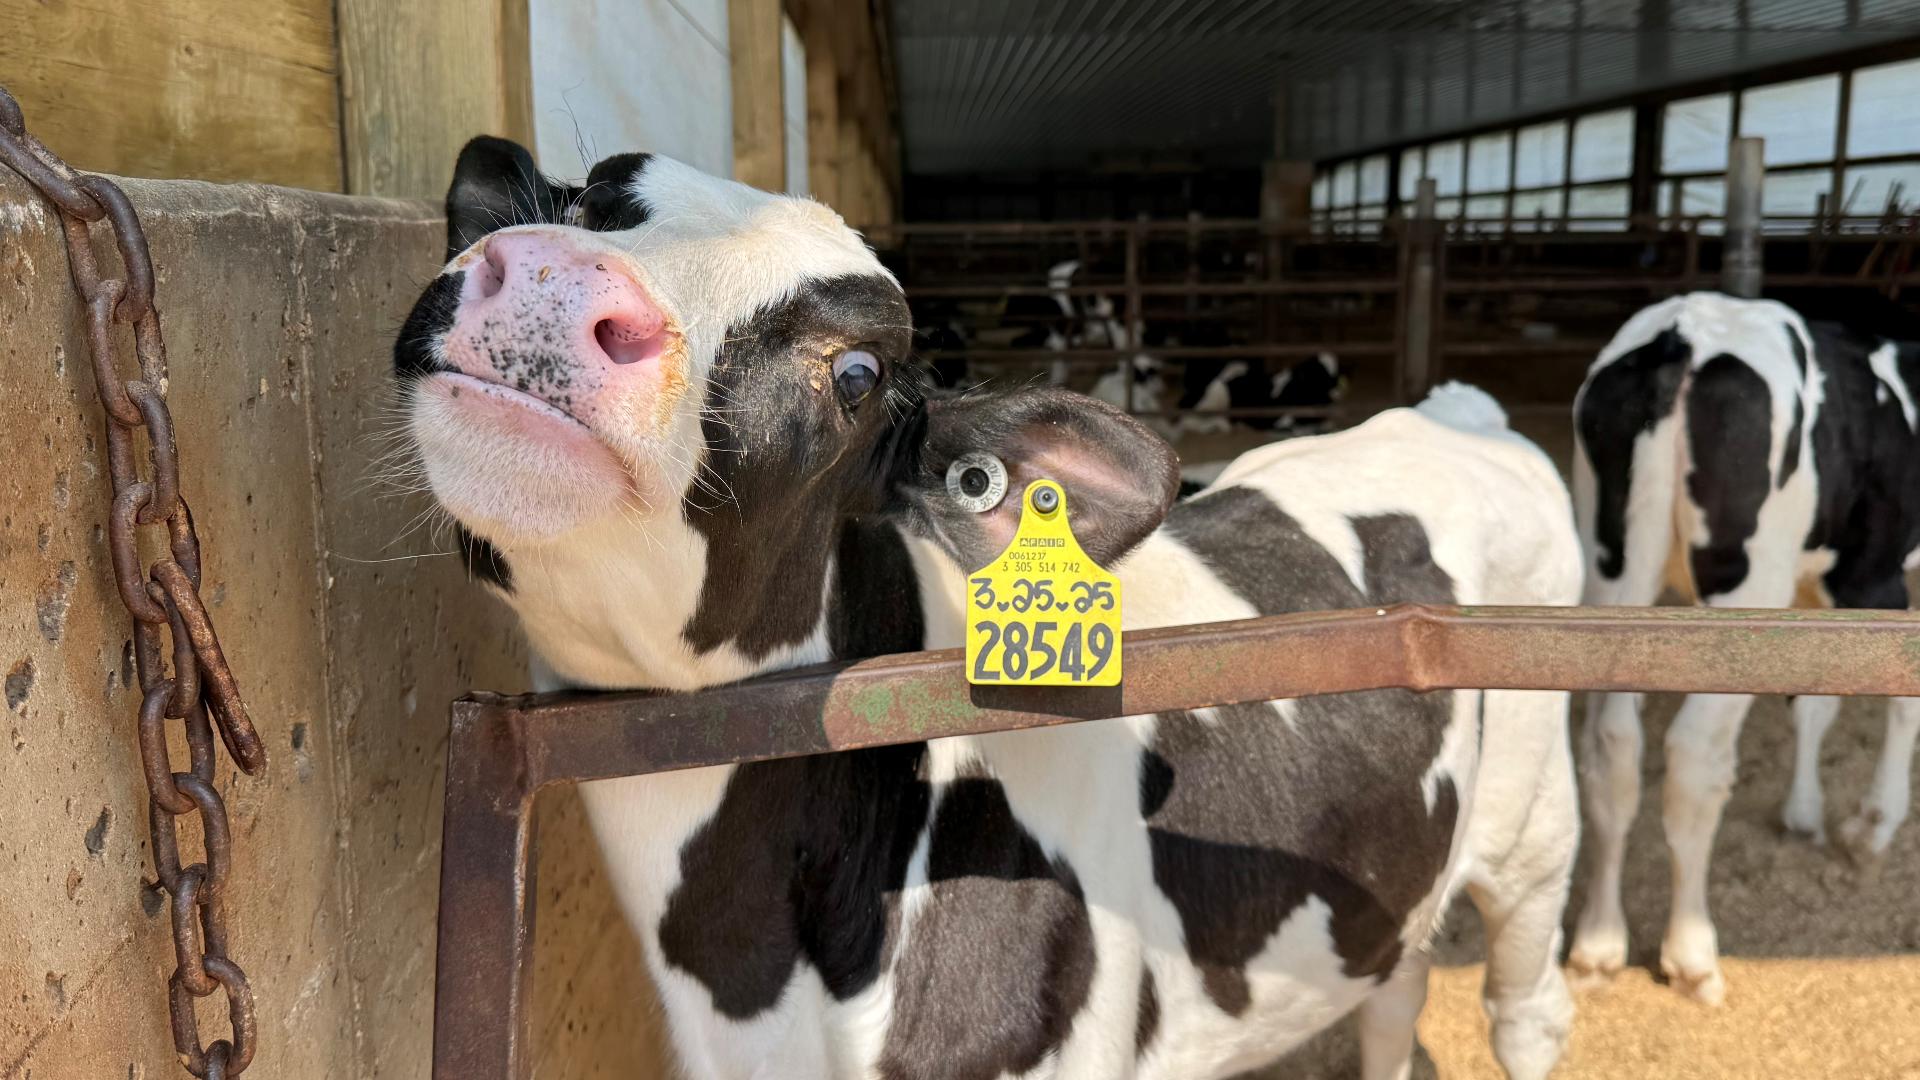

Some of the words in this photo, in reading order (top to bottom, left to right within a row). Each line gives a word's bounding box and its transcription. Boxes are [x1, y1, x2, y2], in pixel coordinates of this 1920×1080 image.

[1019, 538, 1065, 547] AFAIR
[1002, 562, 1009, 572] 3
[1014, 562, 1033, 572] 305
[1039, 562, 1056, 573] 514
[1062, 562, 1081, 573] 742
[973, 620, 1114, 682] 28549
